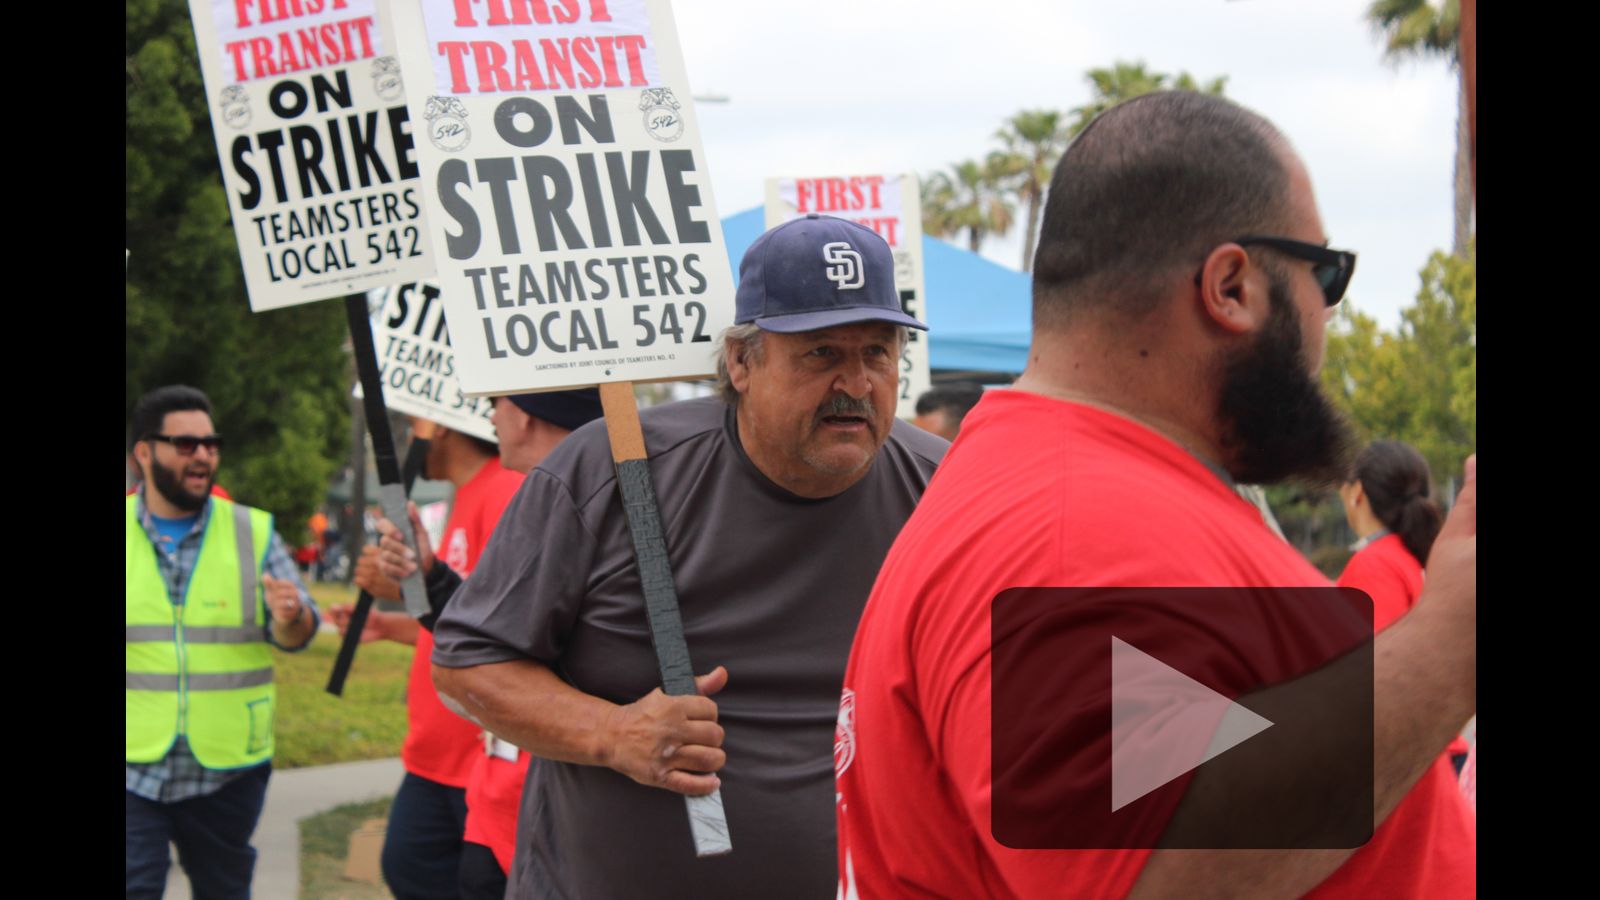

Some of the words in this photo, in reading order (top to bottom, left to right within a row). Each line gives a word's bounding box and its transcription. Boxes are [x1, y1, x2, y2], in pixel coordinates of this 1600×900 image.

[225, 16, 376, 82] TRANSIT
[437, 35, 649, 94] TRANSIT
[269, 69, 353, 119] ON
[494, 94, 616, 148] ON
[434, 123, 465, 140] 542
[650, 115, 679, 130] 542
[231, 105, 420, 210] STRIKE
[253, 188, 419, 247] TEAMSTERS
[437, 149, 711, 261] STRIKE
[795, 175, 885, 213] FIRST
[266, 239, 356, 282] LOCAL
[367, 226, 422, 265] 542
[464, 254, 707, 310] TEAMSTERS
[822, 241, 865, 290] SD
[385, 336, 454, 377] TEAMS
[482, 307, 618, 359] LOCAL
[632, 301, 712, 347] 542
